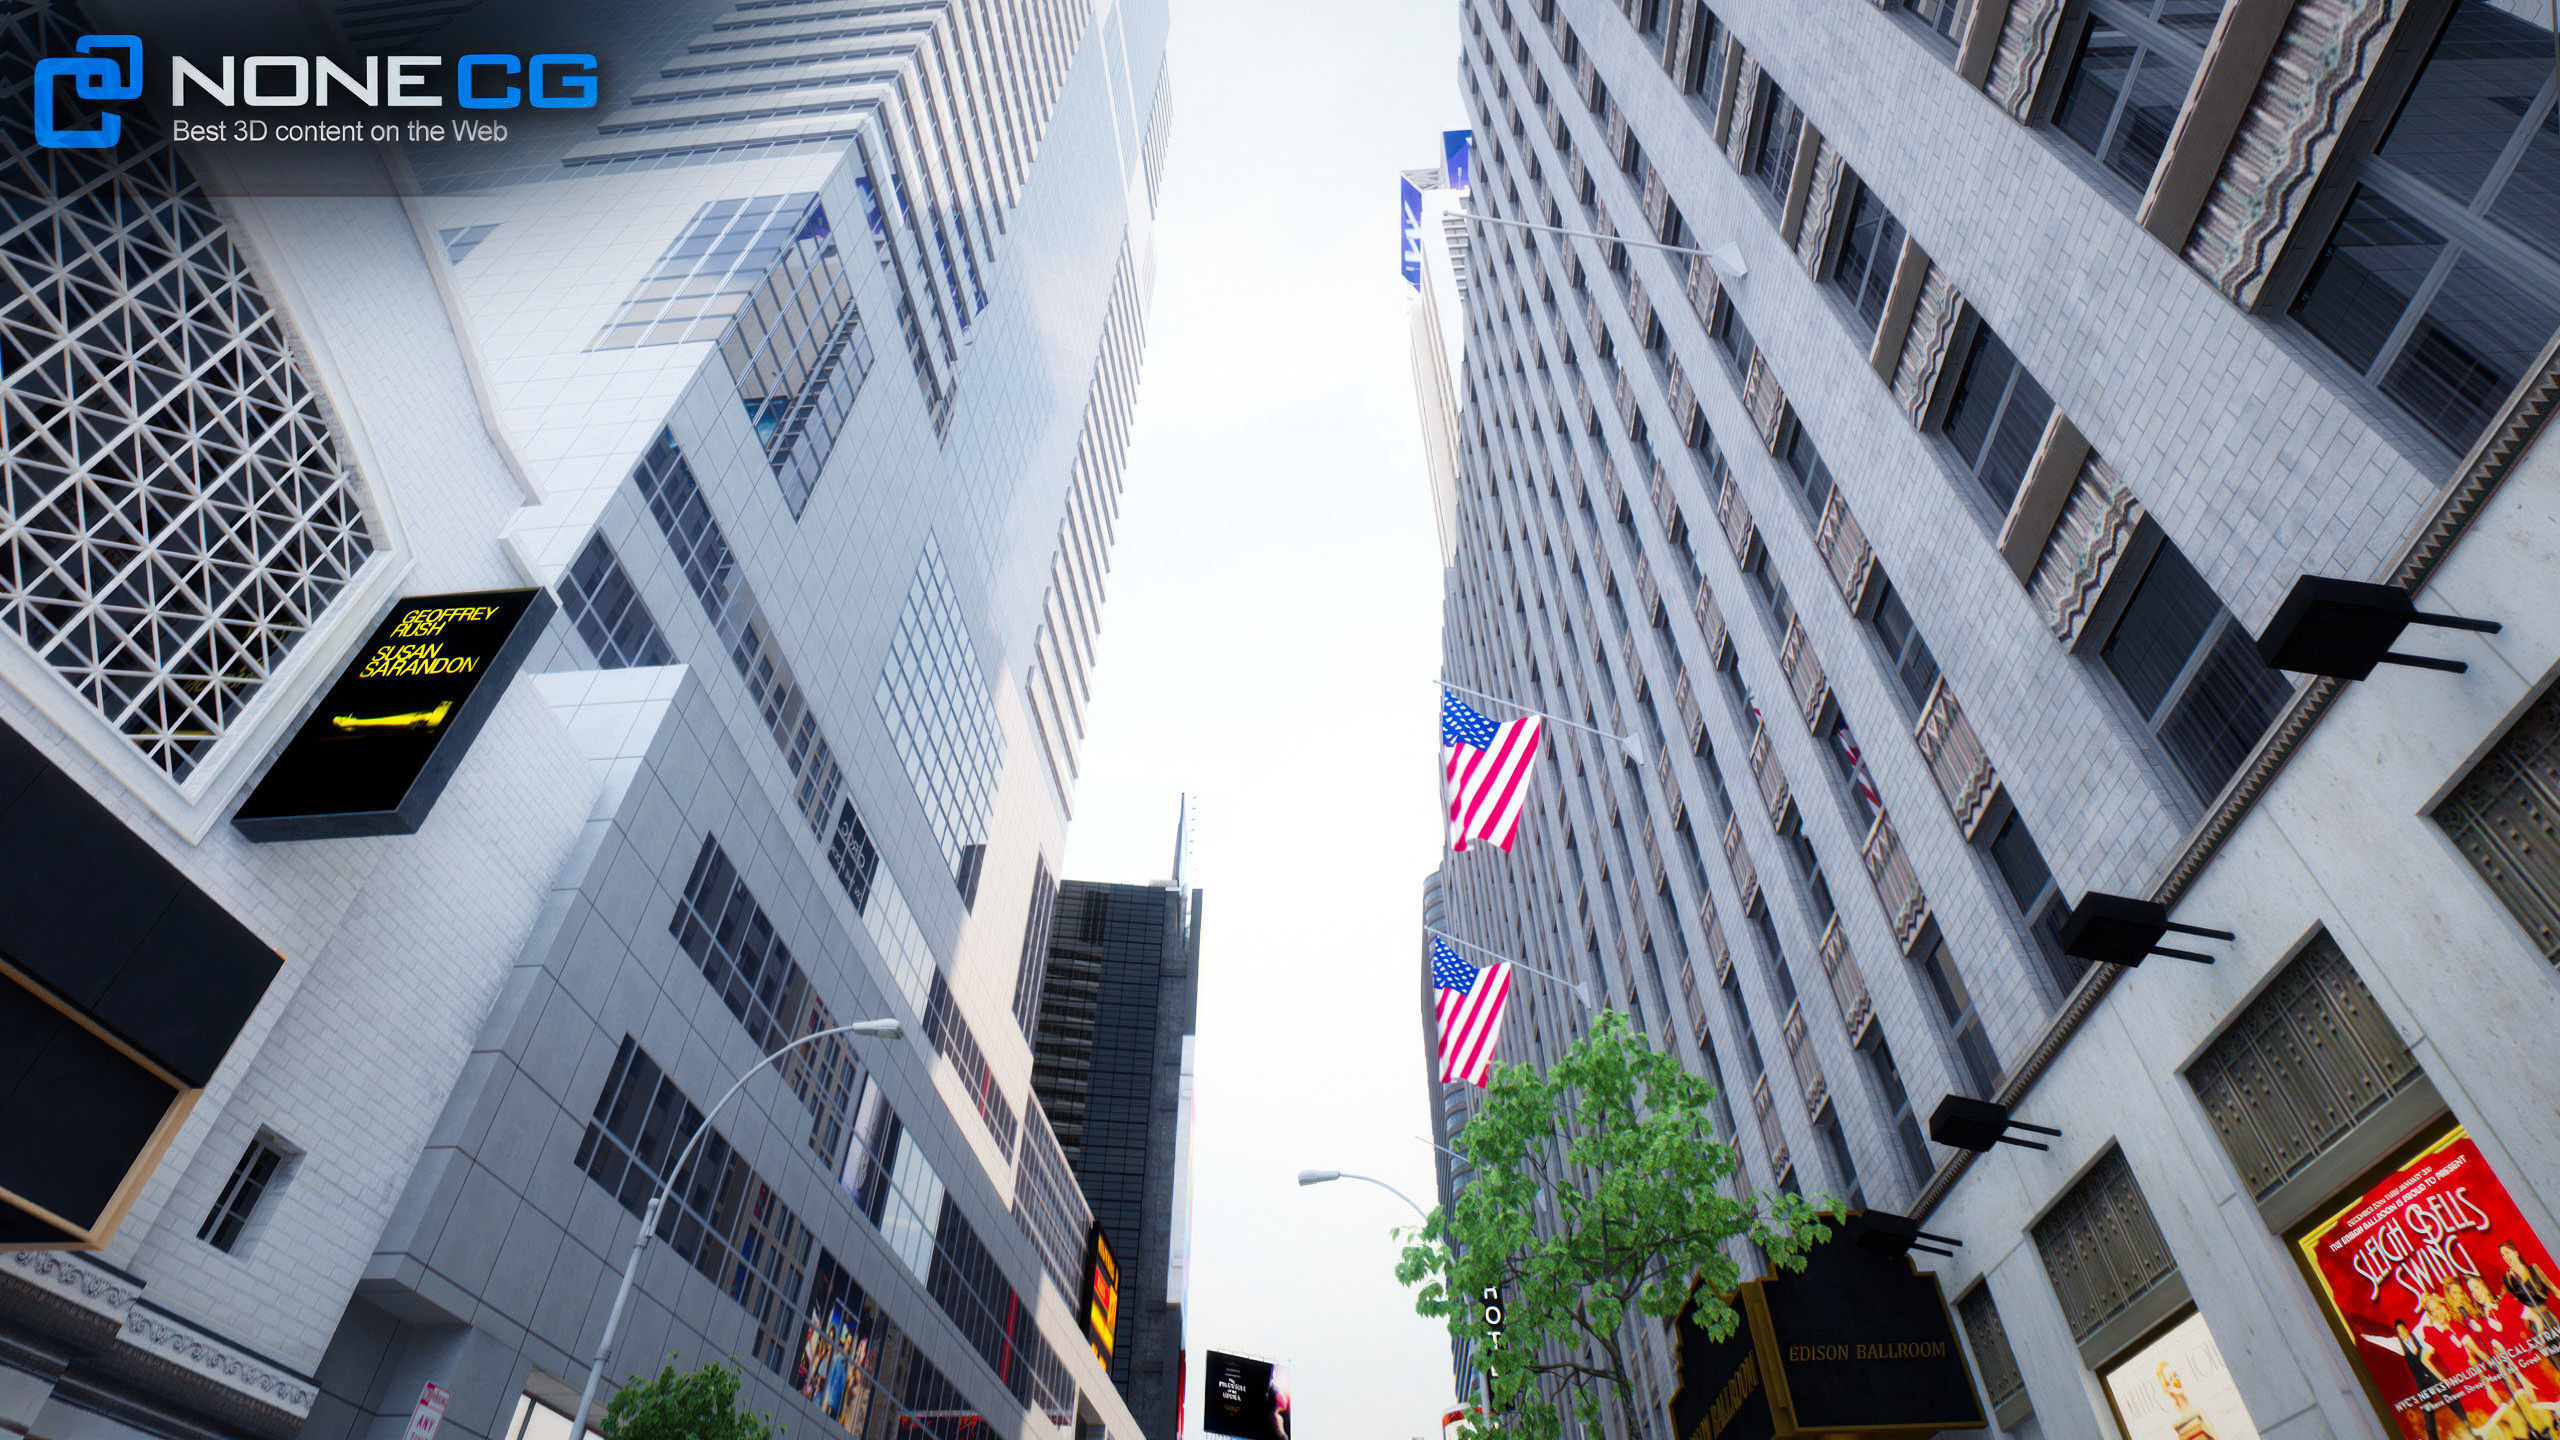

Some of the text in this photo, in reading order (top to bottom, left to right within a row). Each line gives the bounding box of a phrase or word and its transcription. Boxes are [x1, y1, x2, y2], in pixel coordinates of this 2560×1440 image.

[402, 606, 499, 625] GEOFFREY
[390, 621, 447, 638] RUSH
[371, 643, 443, 662] SUSAN
[359, 656, 480, 678] SARANDON
[2353, 1187, 2490, 1300] SLEIGH BELLS
[2395, 1234, 2480, 1313] SWING
[1789, 1341, 1947, 1362] EDISON BALLROOM
[2449, 1362, 2486, 1387] HOLIDAY
[416, 1415, 436, 1433] ANY
